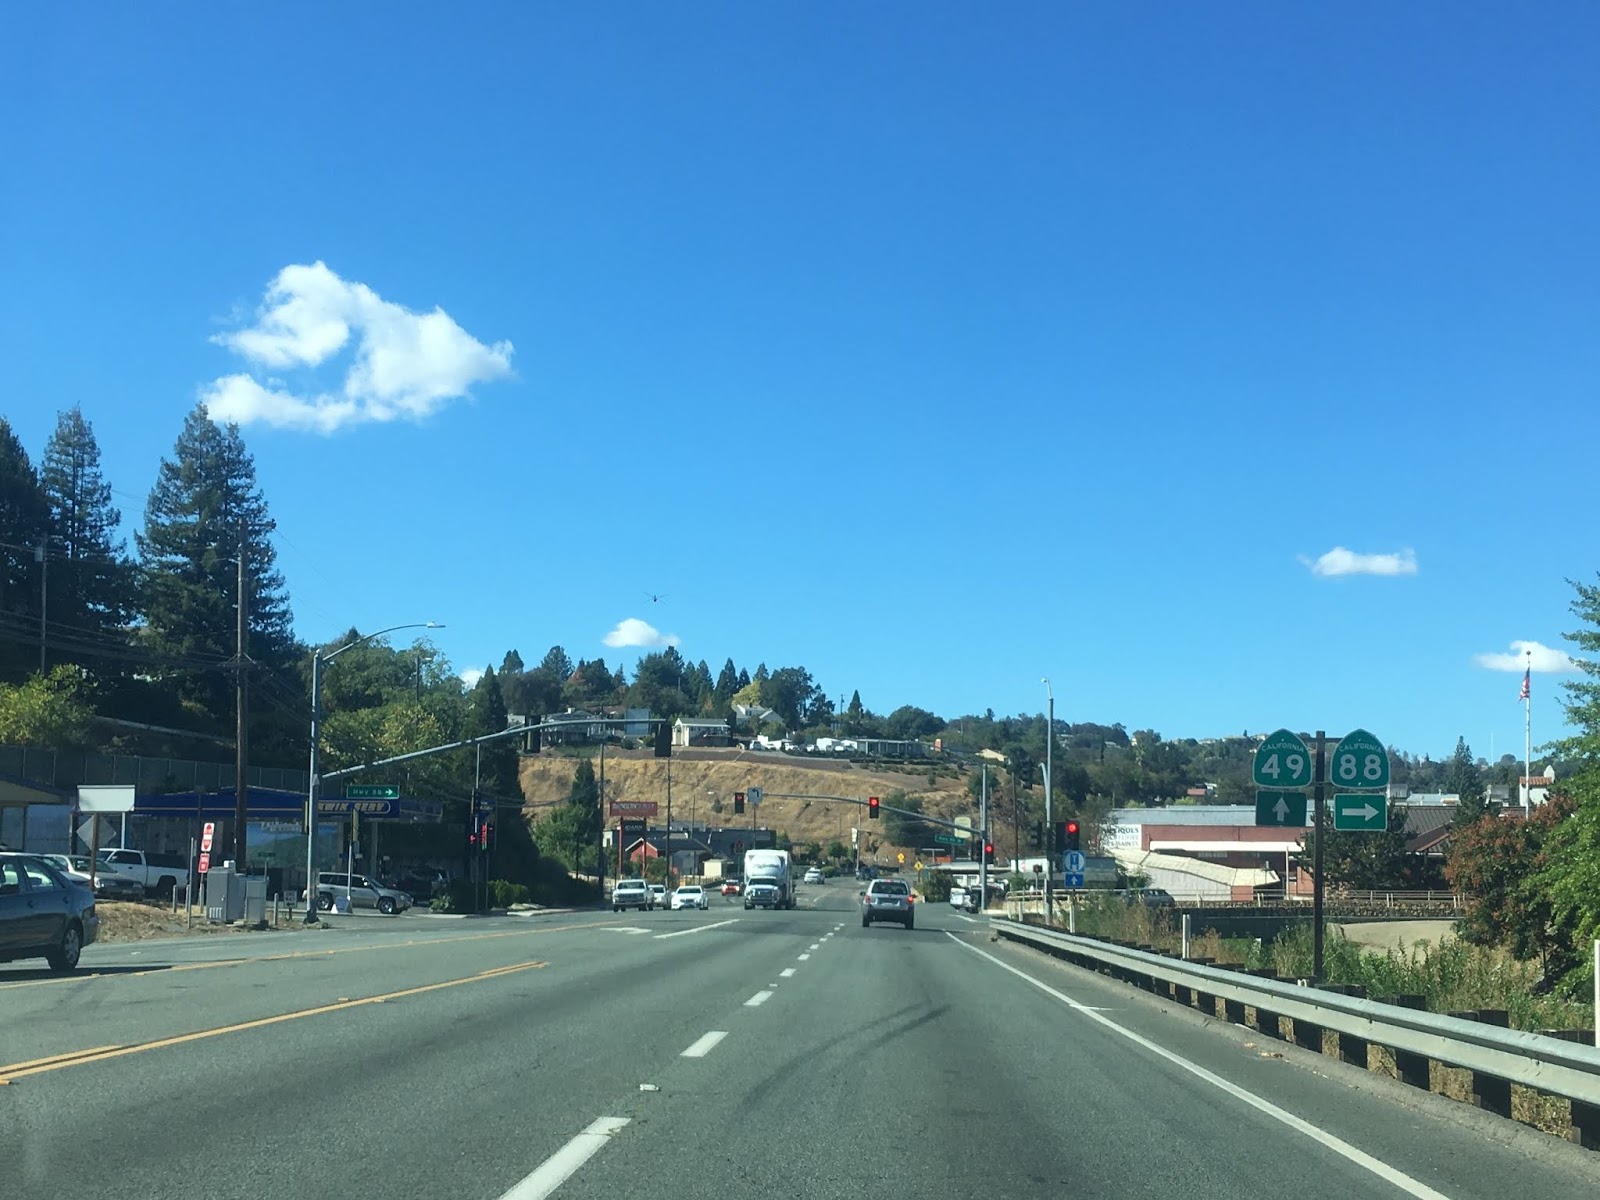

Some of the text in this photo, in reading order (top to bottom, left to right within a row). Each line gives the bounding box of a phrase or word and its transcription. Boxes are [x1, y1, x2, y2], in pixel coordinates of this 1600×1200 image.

[1261, 742, 1304, 753] CALIFORNIA
[1338, 742, 1382, 753] CALIFORNIA
[1261, 754, 1304, 779] 49
[1339, 754, 1382, 780] 88
